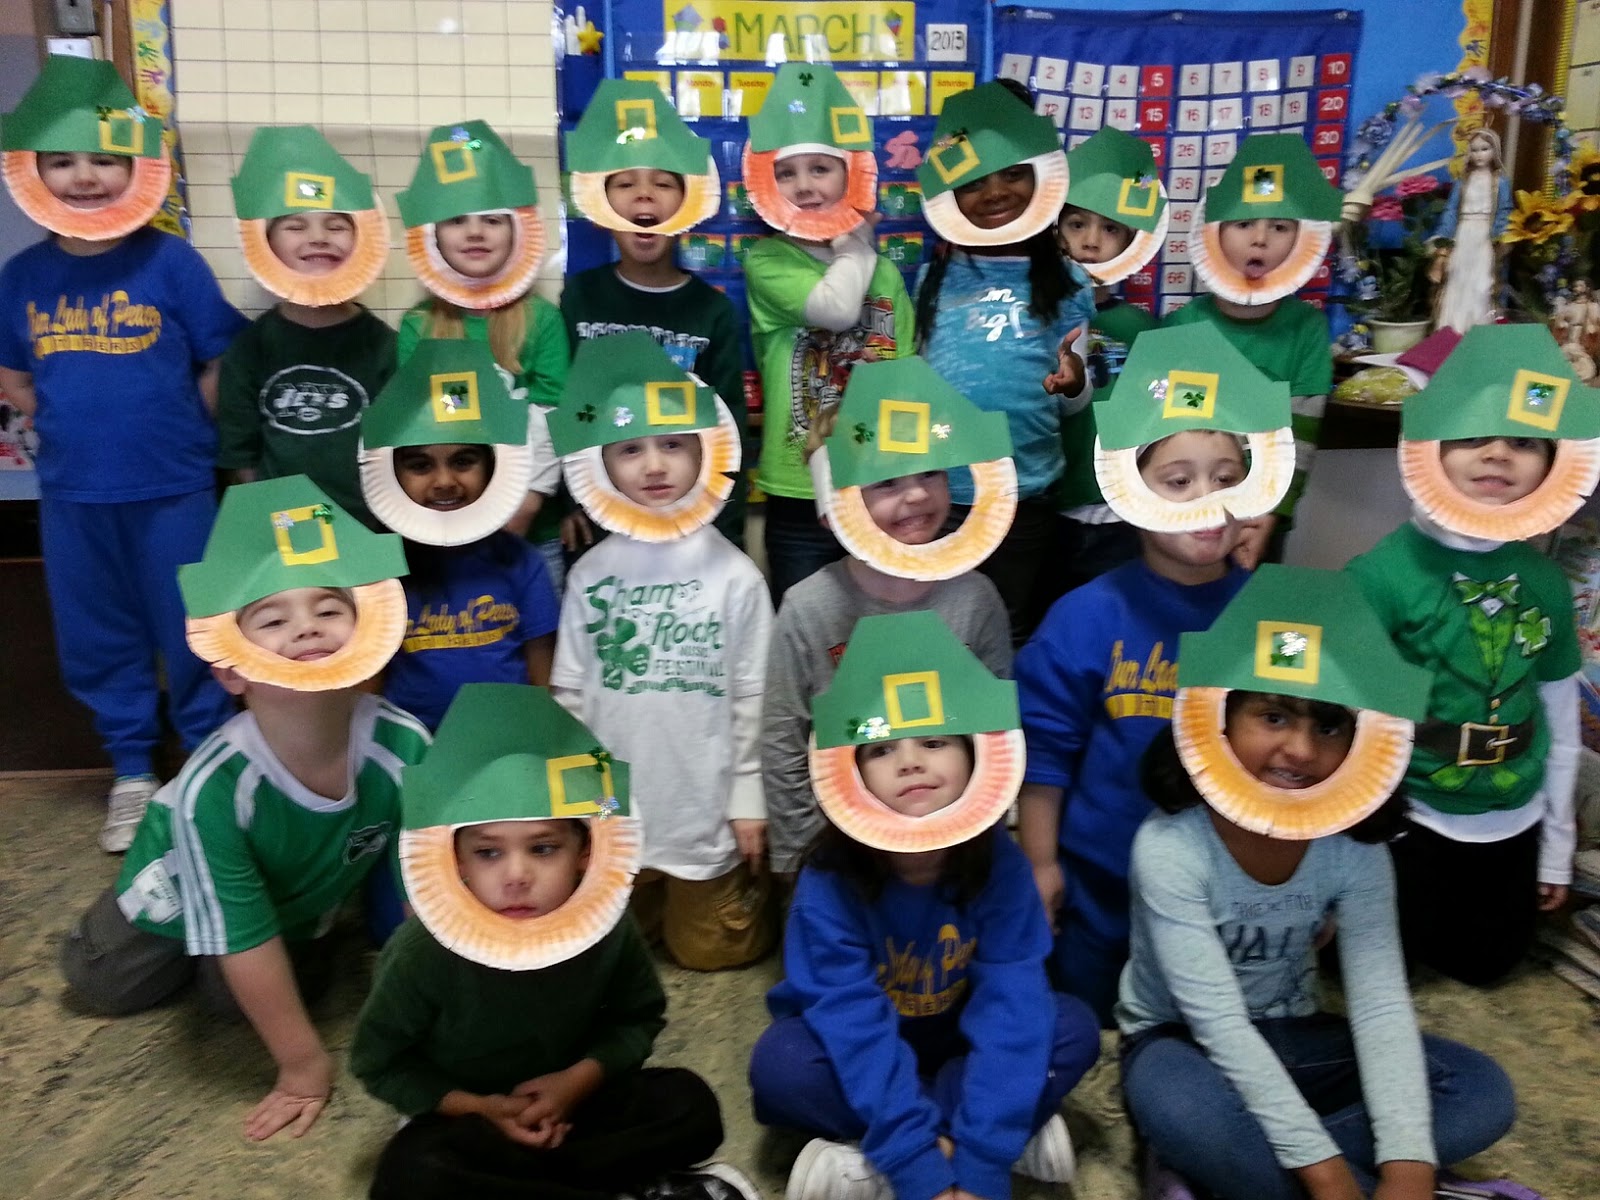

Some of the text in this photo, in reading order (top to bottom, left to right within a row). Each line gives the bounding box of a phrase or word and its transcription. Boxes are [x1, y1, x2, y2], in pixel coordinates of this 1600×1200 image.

[734, 12, 877, 54] MARCH
[931, 30, 965, 51] 2013
[1010, 62, 1019, 75] 1
[1045, 66, 1056, 80] 2
[1258, 67, 1269, 81] 8
[1296, 64, 1305, 77] 9
[1327, 61, 1346, 75] 10
[736, 79, 768, 88] Tuesday
[842, 79, 872, 88] hursday
[935, 79, 969, 88] Saturday
[1083, 71, 1093, 85] 3
[1118, 73, 1128, 85] 4
[1151, 72, 1164, 87] 5
[1189, 72, 1200, 86] 6
[1221, 70, 1232, 83] 7
[1043, 103, 1059, 116] 12
[1257, 103, 1273, 117] 18
[1288, 100, 1301, 114] 19
[1320, 96, 1344, 111] 20
[1079, 106, 1094, 120] 13
[1112, 108, 1128, 119] 14
[1145, 107, 1163, 122] 15
[1186, 108, 1200, 122] 16
[1217, 106, 1233, 120] 17
[1317, 130, 1340, 145] 30
[1150, 143, 1162, 158] 5
[1177, 144, 1196, 157] 26
[1210, 141, 1230, 156] 27
[1175, 177, 1194, 190] 36
[1171, 210, 1192, 222] 46
[888, 246, 905, 260] 15
[1168, 240, 1188, 253] 56
[1166, 271, 1187, 284] 66
[652, 611, 723, 652] Rock
[1141, 641, 1180, 693] La
